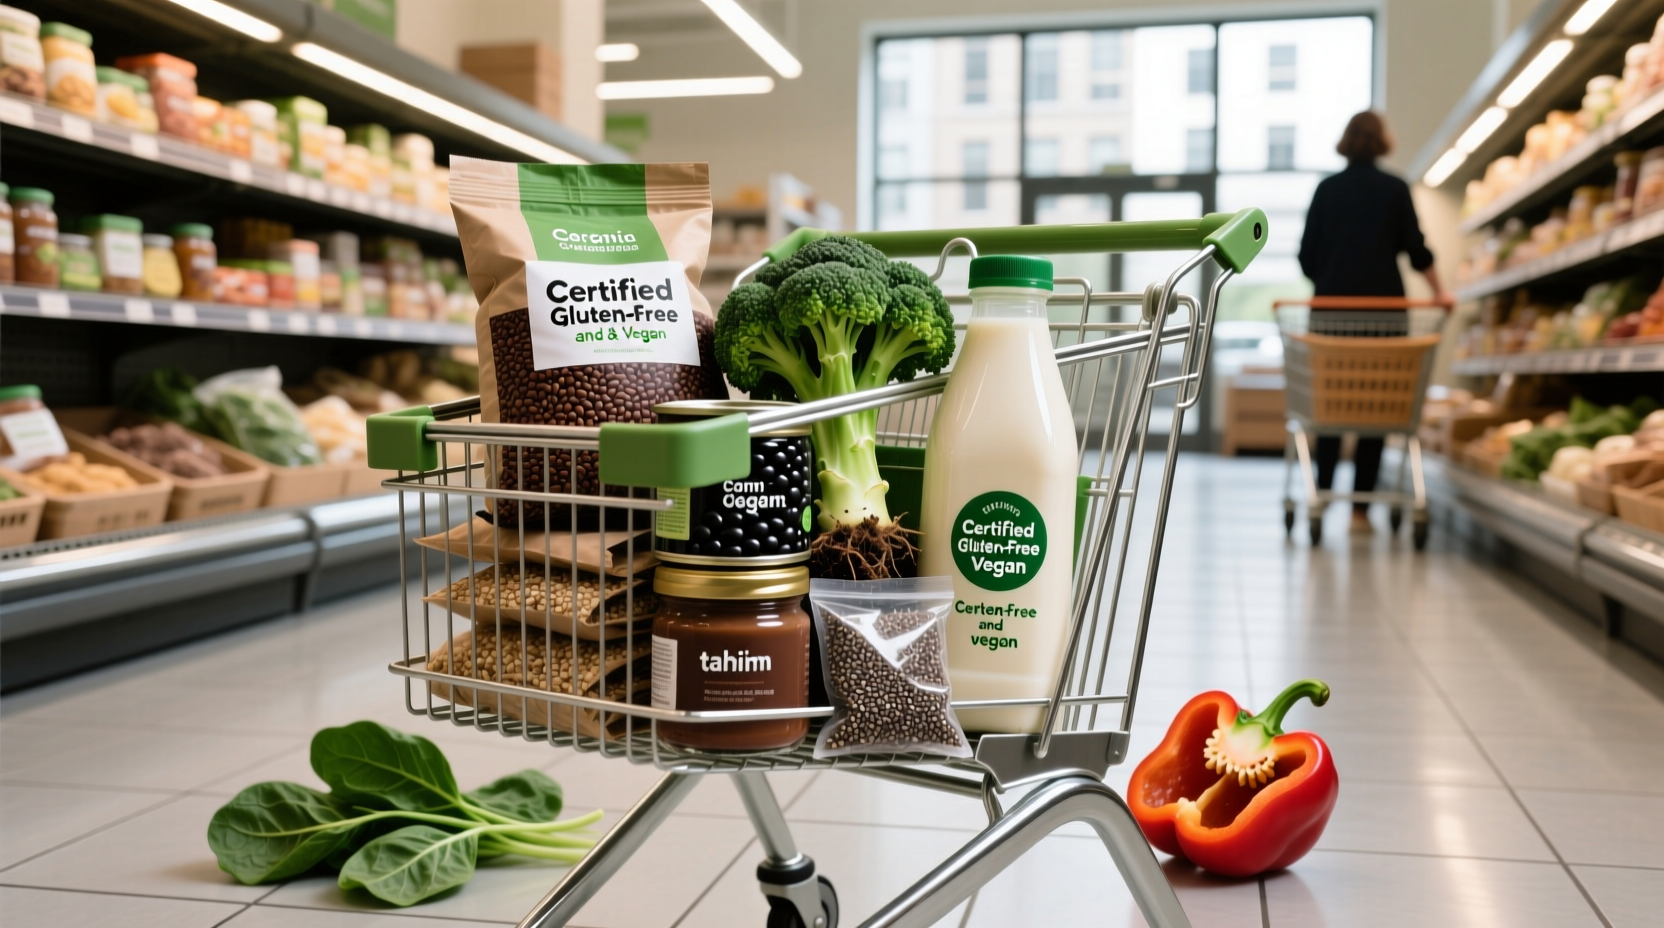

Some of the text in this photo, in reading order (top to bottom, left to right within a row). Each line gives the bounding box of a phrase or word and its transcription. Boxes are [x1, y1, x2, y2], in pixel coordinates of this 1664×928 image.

[546, 278, 673, 303] Certified
[550, 304, 678, 327] Gluten-Free
[575, 327, 603, 342] and
[622, 326, 666, 343] Vegan
[962, 519, 1035, 538] Certified
[957, 538, 1040, 556] Gluten-Free
[971, 556, 1027, 578] Vegan
[978, 618, 1003, 631] and
[971, 635, 1018, 651] vegan
